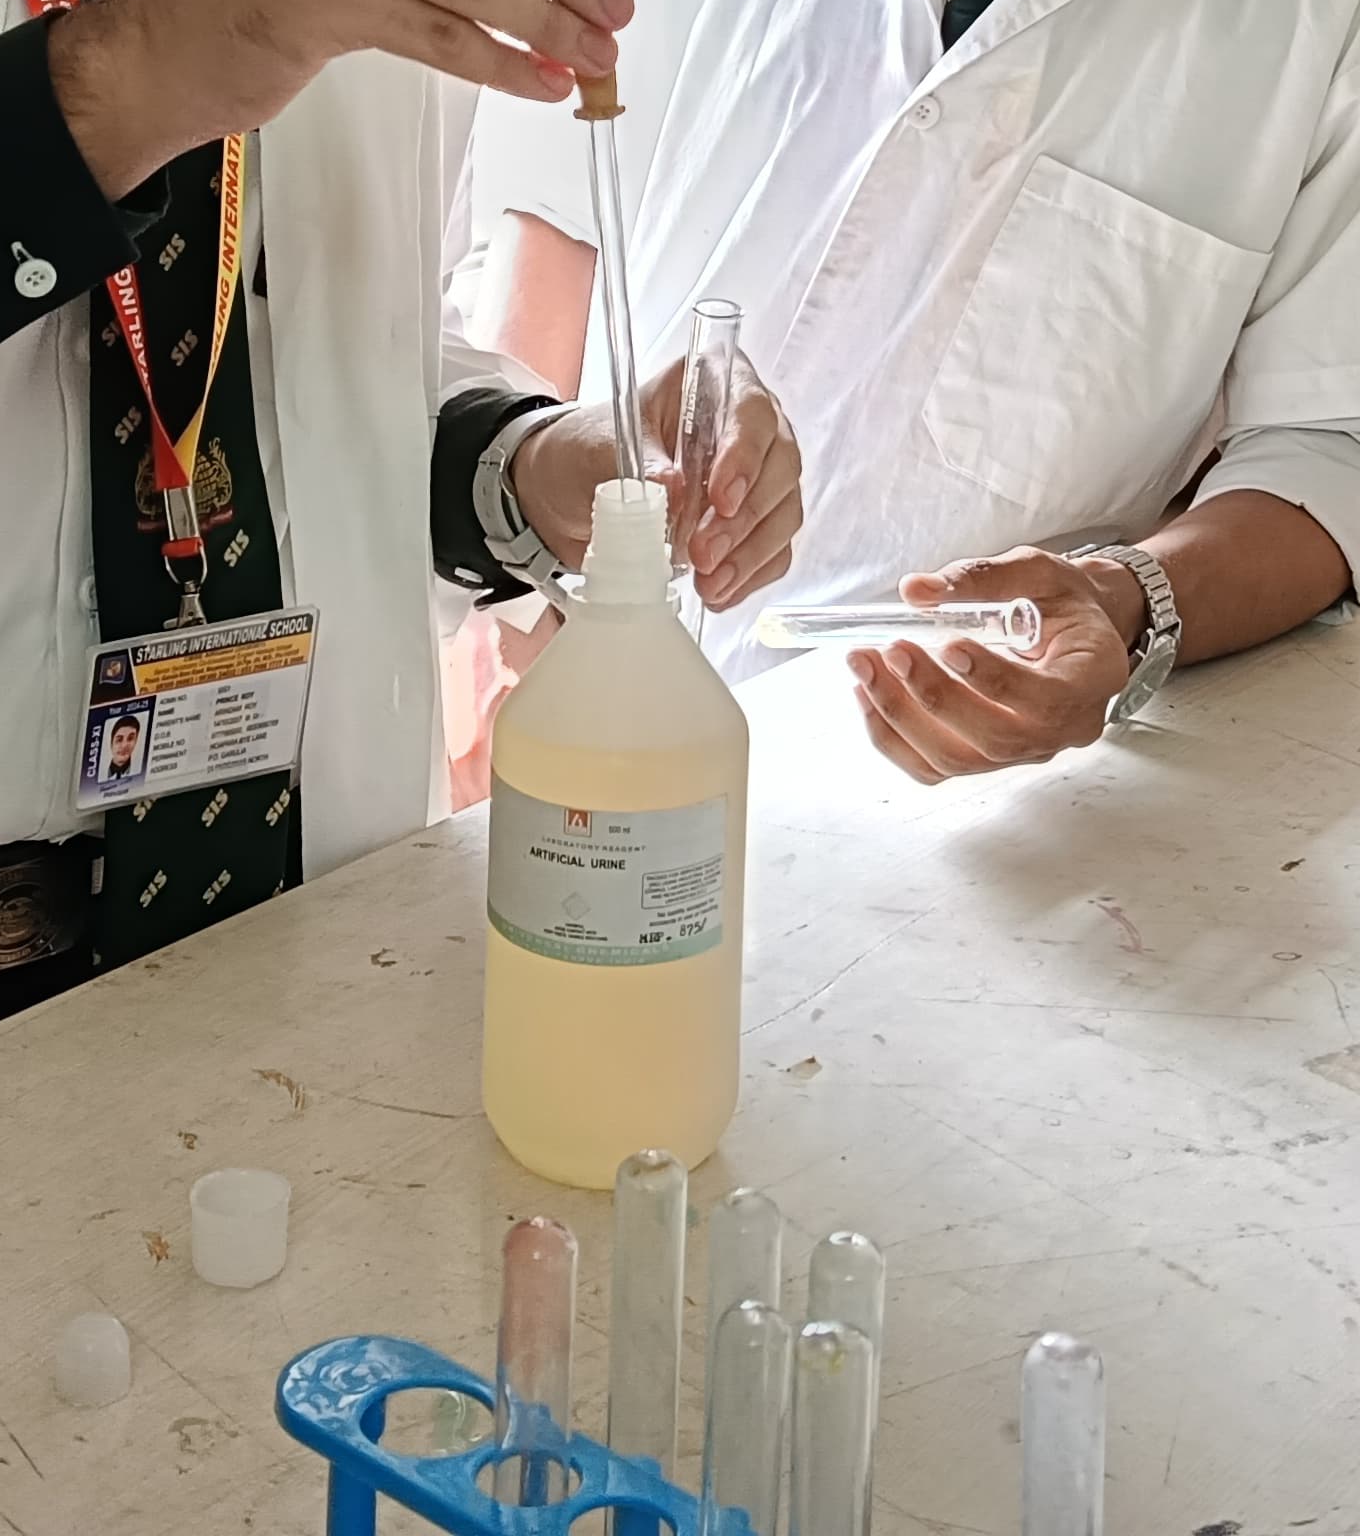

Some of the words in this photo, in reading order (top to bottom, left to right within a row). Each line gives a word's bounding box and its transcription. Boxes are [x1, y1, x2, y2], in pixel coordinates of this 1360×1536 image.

[158, 233, 186, 271] SIS
[170, 329, 199, 366] SIS
[114, 406, 142, 445] SIS
[223, 529, 250, 567] SIS
[136, 639, 188, 664] STARLING
[188, 622, 269, 652] INTERNATIONAL
[269, 616, 309, 637] SCHOOL
[201, 788, 228, 828] SIS
[265, 788, 290, 827] SIS
[530, 846, 585, 867] ARTIFICIAL
[591, 858, 626, 870] URINE
[140, 869, 167, 908] SIS
[202, 869, 231, 905] SIS
